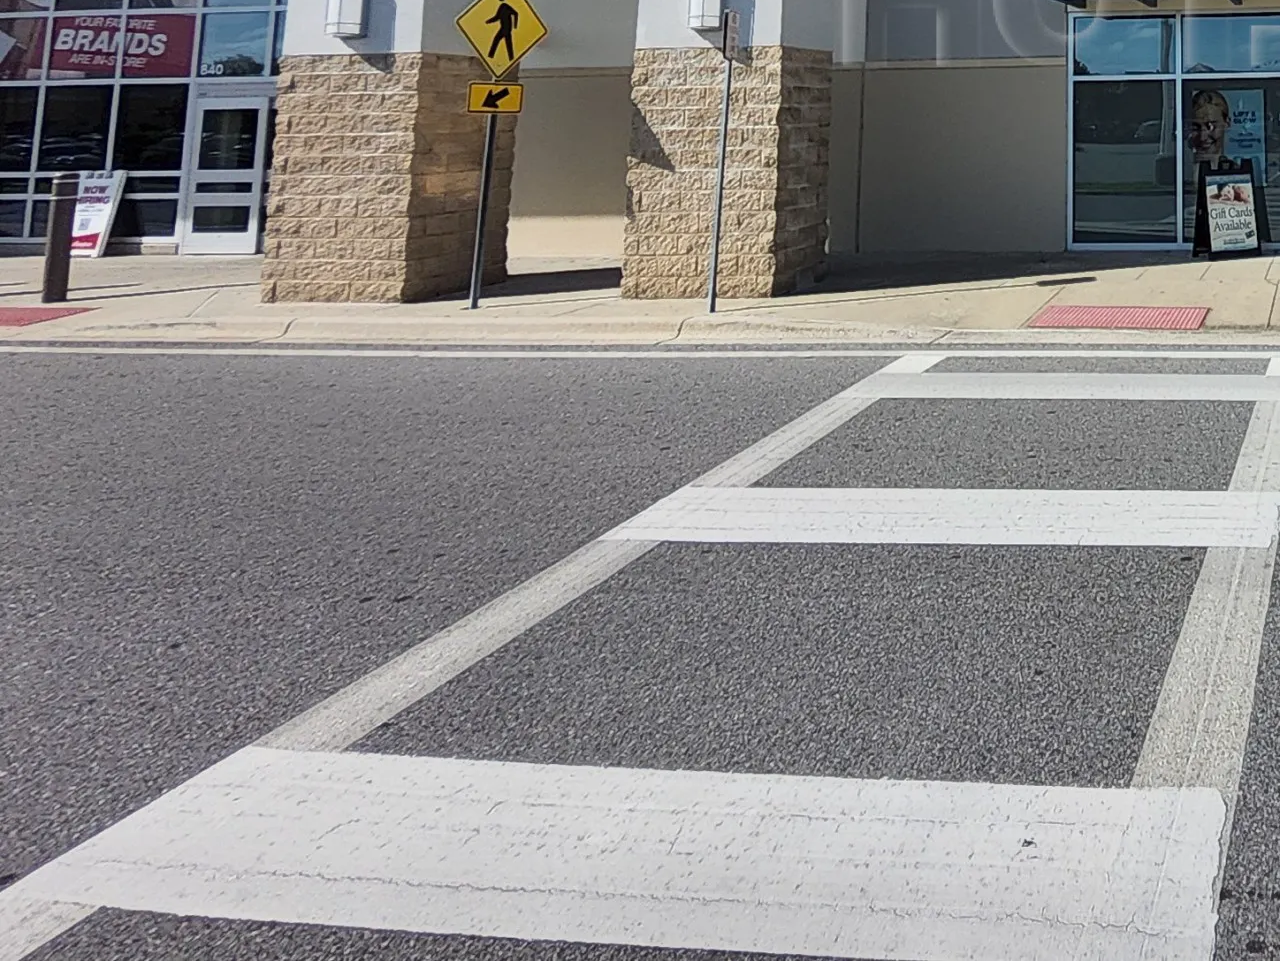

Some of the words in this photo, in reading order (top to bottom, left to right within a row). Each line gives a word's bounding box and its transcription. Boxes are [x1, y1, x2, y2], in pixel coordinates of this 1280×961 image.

[54, 29, 168, 56] BRANDS
[200, 64, 223, 75] 840
[82, 185, 109, 194] NOW
[1228, 206, 1253, 218] Cards
[1213, 219, 1252, 233] Available
